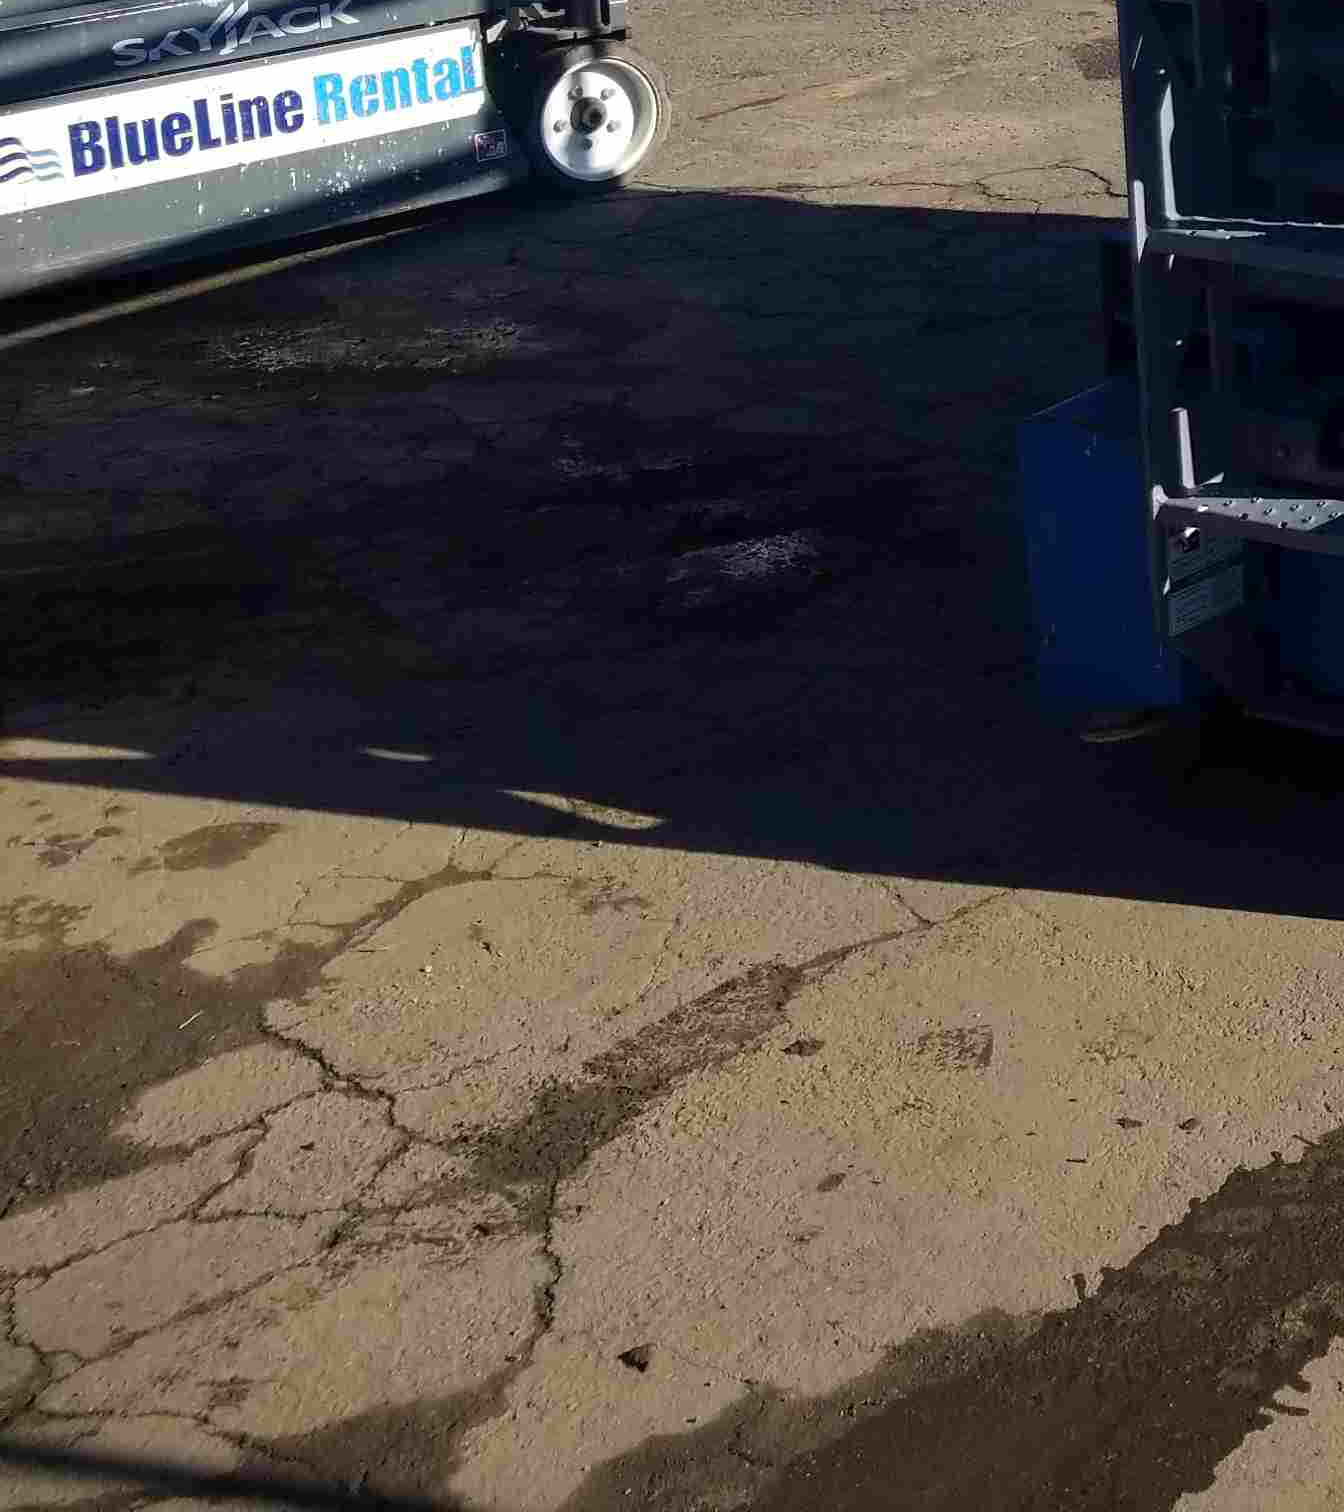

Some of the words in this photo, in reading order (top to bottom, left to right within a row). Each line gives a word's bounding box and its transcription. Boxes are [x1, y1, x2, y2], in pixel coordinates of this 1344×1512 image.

[111, 0, 361, 67] SKYJACK
[67, 88, 304, 178] BlueLine
[313, 45, 477, 126] Rental
